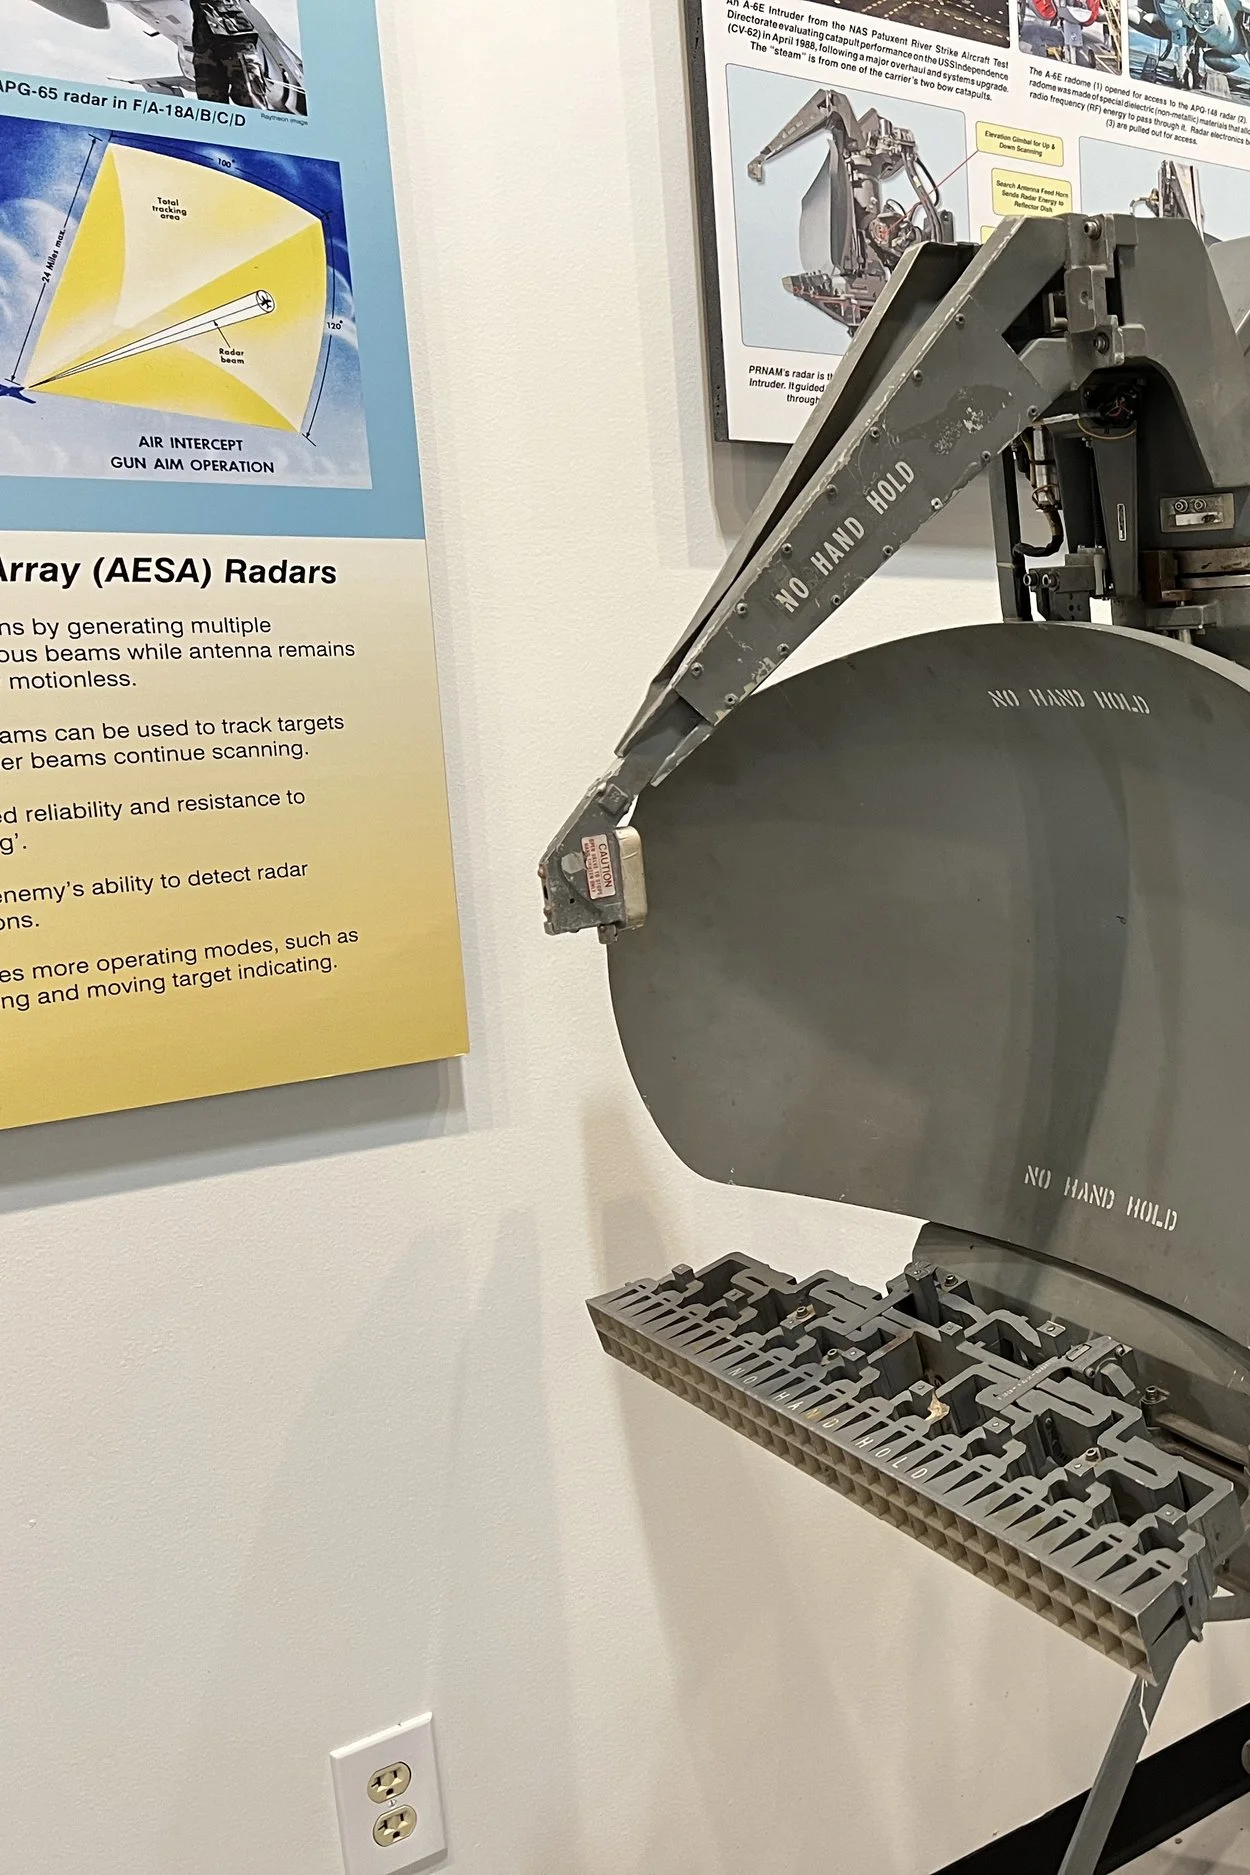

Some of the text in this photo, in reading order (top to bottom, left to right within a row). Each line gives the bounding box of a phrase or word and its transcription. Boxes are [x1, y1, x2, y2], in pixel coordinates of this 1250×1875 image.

[727, 9, 1008, 81] Directorate evaluating catapult performance on the USS Independence
[742, 0, 765, 13] A-6E
[768, 5, 804, 21] Intruder
[807, 14, 828, 27] from
[831, 20, 845, 31] the
[848, 24, 868, 36] NAS
[871, 29, 908, 46] Patuxent
[910, 38, 932, 51] River
[935, 44, 958, 57] Strike
[961, 50, 990, 64] Aircraft
[993, 57, 1008, 69] Test
[727, 22, 1009, 93] (CV-62) in April 1988, following a major overhaul and systems upgrade.
[750, 40, 992, 101] The "steam" is from one of the carrier's two bow catapults.
[0, 80, 246, 127] PG-65 radar in F/A-18A/B/C/D
[152, 205, 187, 217] tracking
[157, 197, 179, 207] Total
[160, 213, 180, 221] area
[41, 229, 66, 283] 24 Miles max.
[219, 348, 244, 356] Radar
[220, 356, 245, 365] beam
[748, 364, 790, 377] PRNAM's
[791, 370, 815, 379] radar
[816, 371, 824, 380] is
[749, 378, 825, 393] Intruder. It guided
[138, 435, 243, 451] AIR INTERCEPT
[110, 456, 274, 473] GUN AIM OPERATION
[775, 461, 915, 613] NO HAND HOLD
[93, 557, 211, 589] (AESA)
[225, 558, 336, 584] Radars
[32, 616, 271, 640] by generating multiple
[45, 644, 120, 662] beams
[126, 642, 182, 660] while
[189, 643, 272, 659] antenna
[278, 640, 355, 657] remains
[9, 670, 136, 689] motionless.
[987, 689, 1150, 715] NO HAND HOLD
[54, 727, 95, 741] can
[102, 722, 129, 739] be
[137, 719, 188, 738] used
[194, 719, 215, 735] to
[221, 716, 272, 734] track
[277, 715, 344, 735] targets
[1, 740, 308, 770] er beams continue scanning.
[25, 800, 122, 822] reliability
[130, 796, 170, 815] and
[177, 793, 280, 812] resistance
[286, 789, 305, 805] to
[92, 875, 154, 895] ability
[159, 873, 180, 889] to
[187, 866, 251, 886] detect
[257, 861, 308, 880] radar
[598, 843, 612, 888] CAUTION
[0, 930, 358, 983] es more operating modes, such as
[1, 956, 337, 1011] ng and moving target indicating.
[1024, 1164, 1178, 1232] NO HAND HOLD
[728, 1367, 929, 1480] NO HAND HOLD
